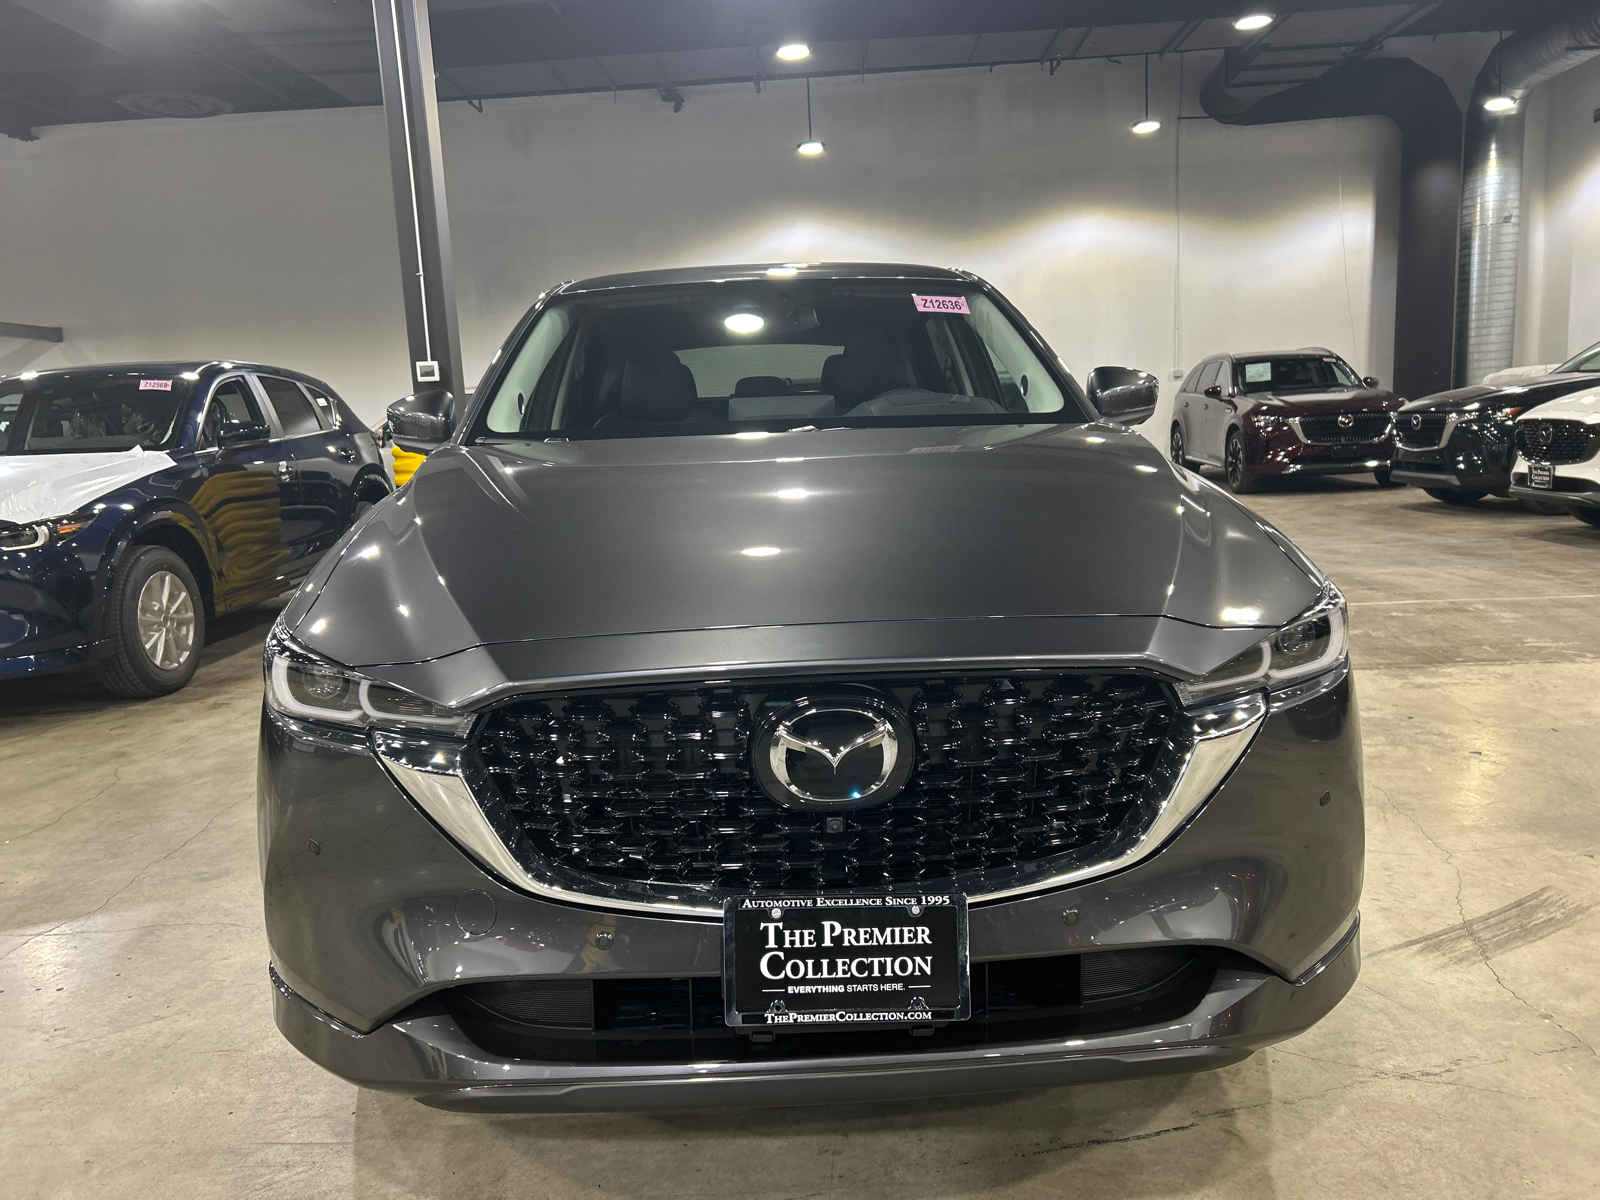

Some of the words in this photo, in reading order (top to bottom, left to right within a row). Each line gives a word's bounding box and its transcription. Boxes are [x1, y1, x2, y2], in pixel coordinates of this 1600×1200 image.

[921, 299, 962, 310] Z12636
[742, 898, 813, 908] AUTOMOTIVE
[816, 896, 882, 907] EXCELLENCE
[885, 896, 917, 906] SINCE
[920, 895, 950, 905] 1995
[760, 921, 816, 948] THE
[821, 920, 932, 947] PREMIER
[760, 951, 932, 979] COLLECTION
[787, 985, 845, 994] EVERYTHING
[846, 984, 879, 993] STARTS
[880, 982, 906, 992] HERE.
